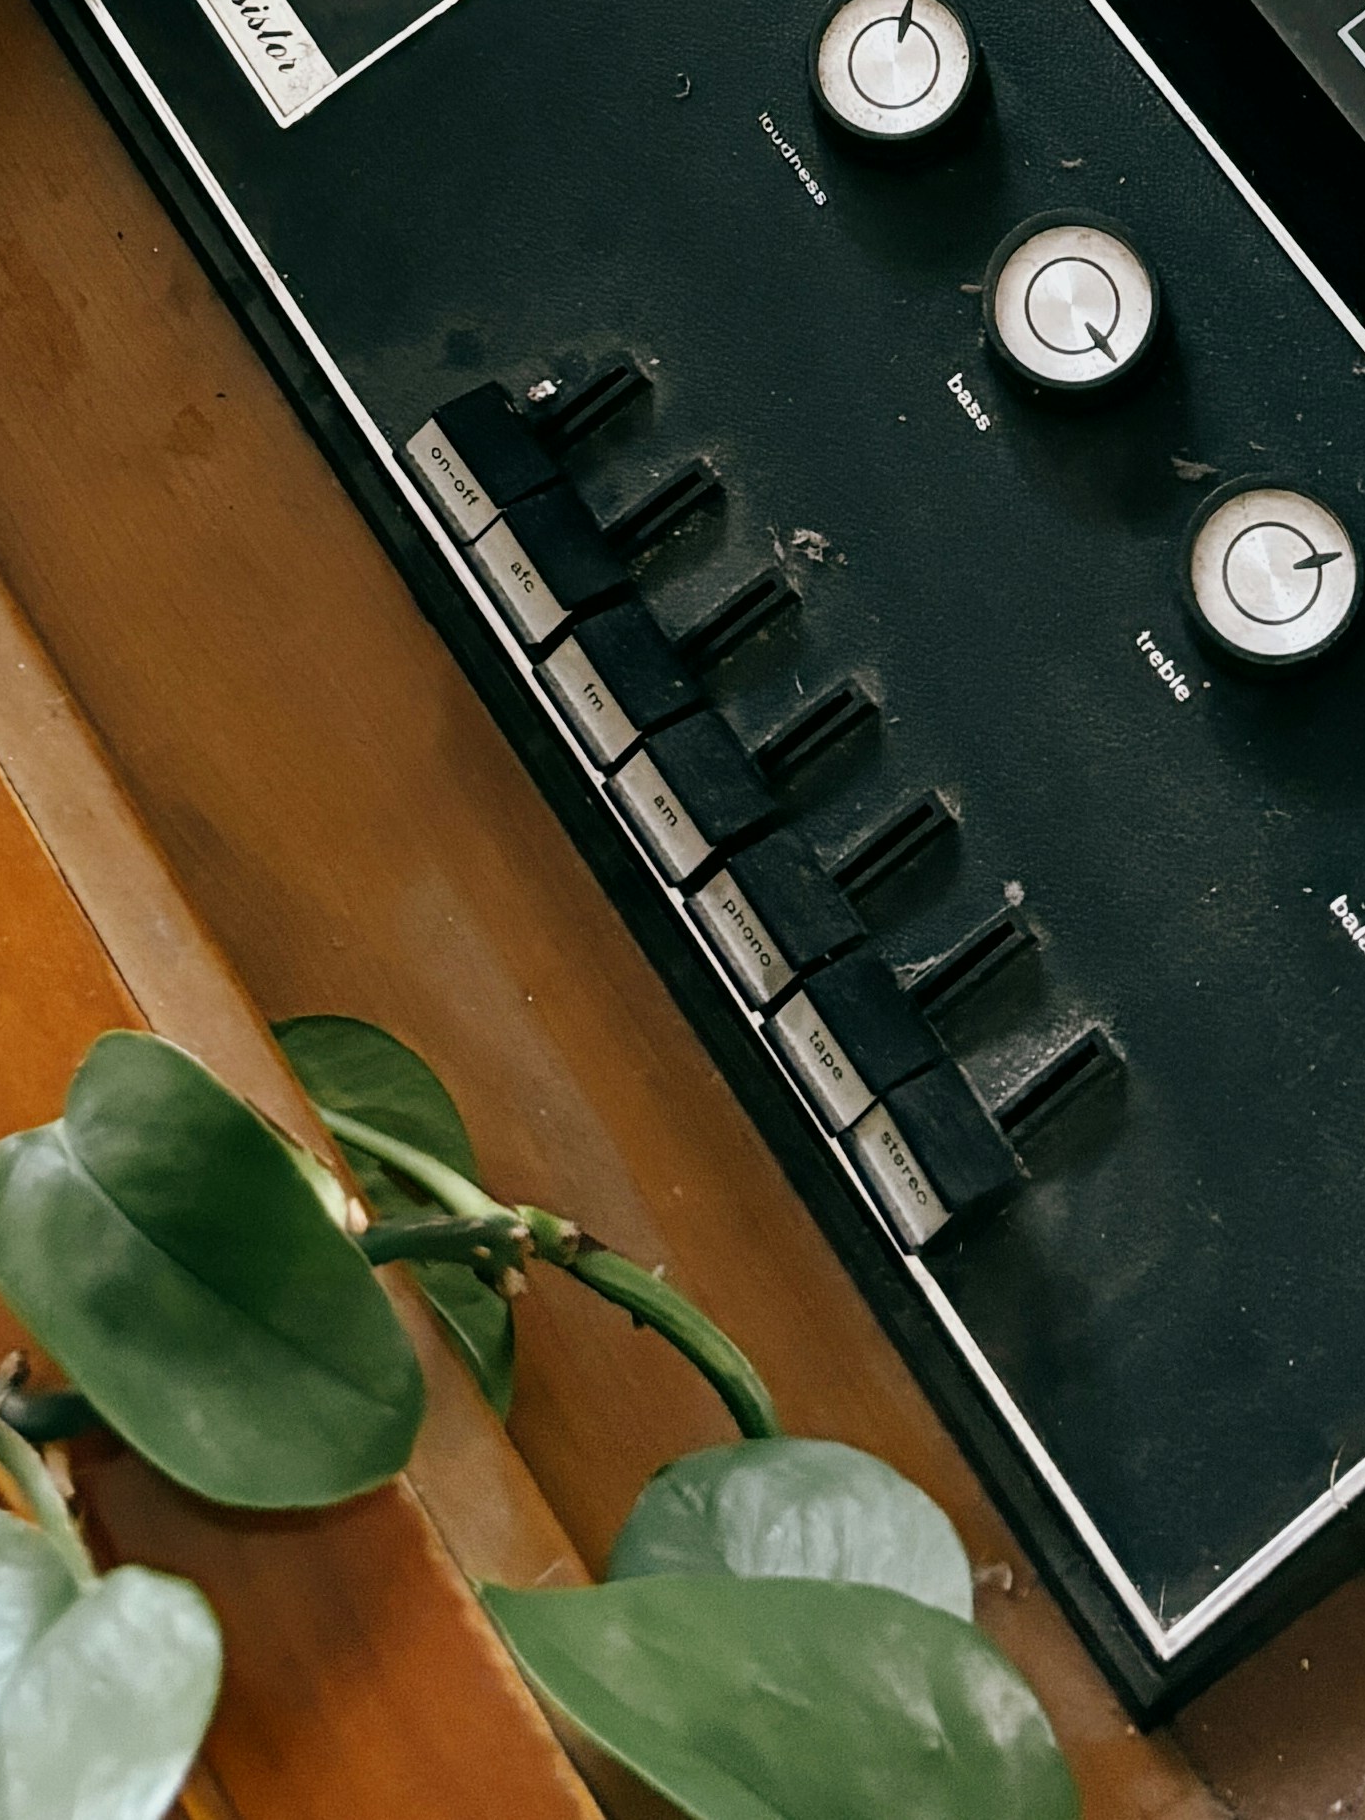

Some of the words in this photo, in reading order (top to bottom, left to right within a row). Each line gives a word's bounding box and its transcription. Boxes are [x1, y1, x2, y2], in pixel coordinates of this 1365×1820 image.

[757, 110, 827, 206] loudness
[945, 371, 991, 431] bass
[430, 446, 480, 506] on-off
[509, 561, 535, 594] afc
[1135, 629, 1190, 702] treble
[582, 682, 604, 711] fm
[652, 794, 678, 827] am
[721, 898, 772, 968] phono
[808, 1029, 843, 1081] tape
[880, 1129, 928, 1206] stereo
